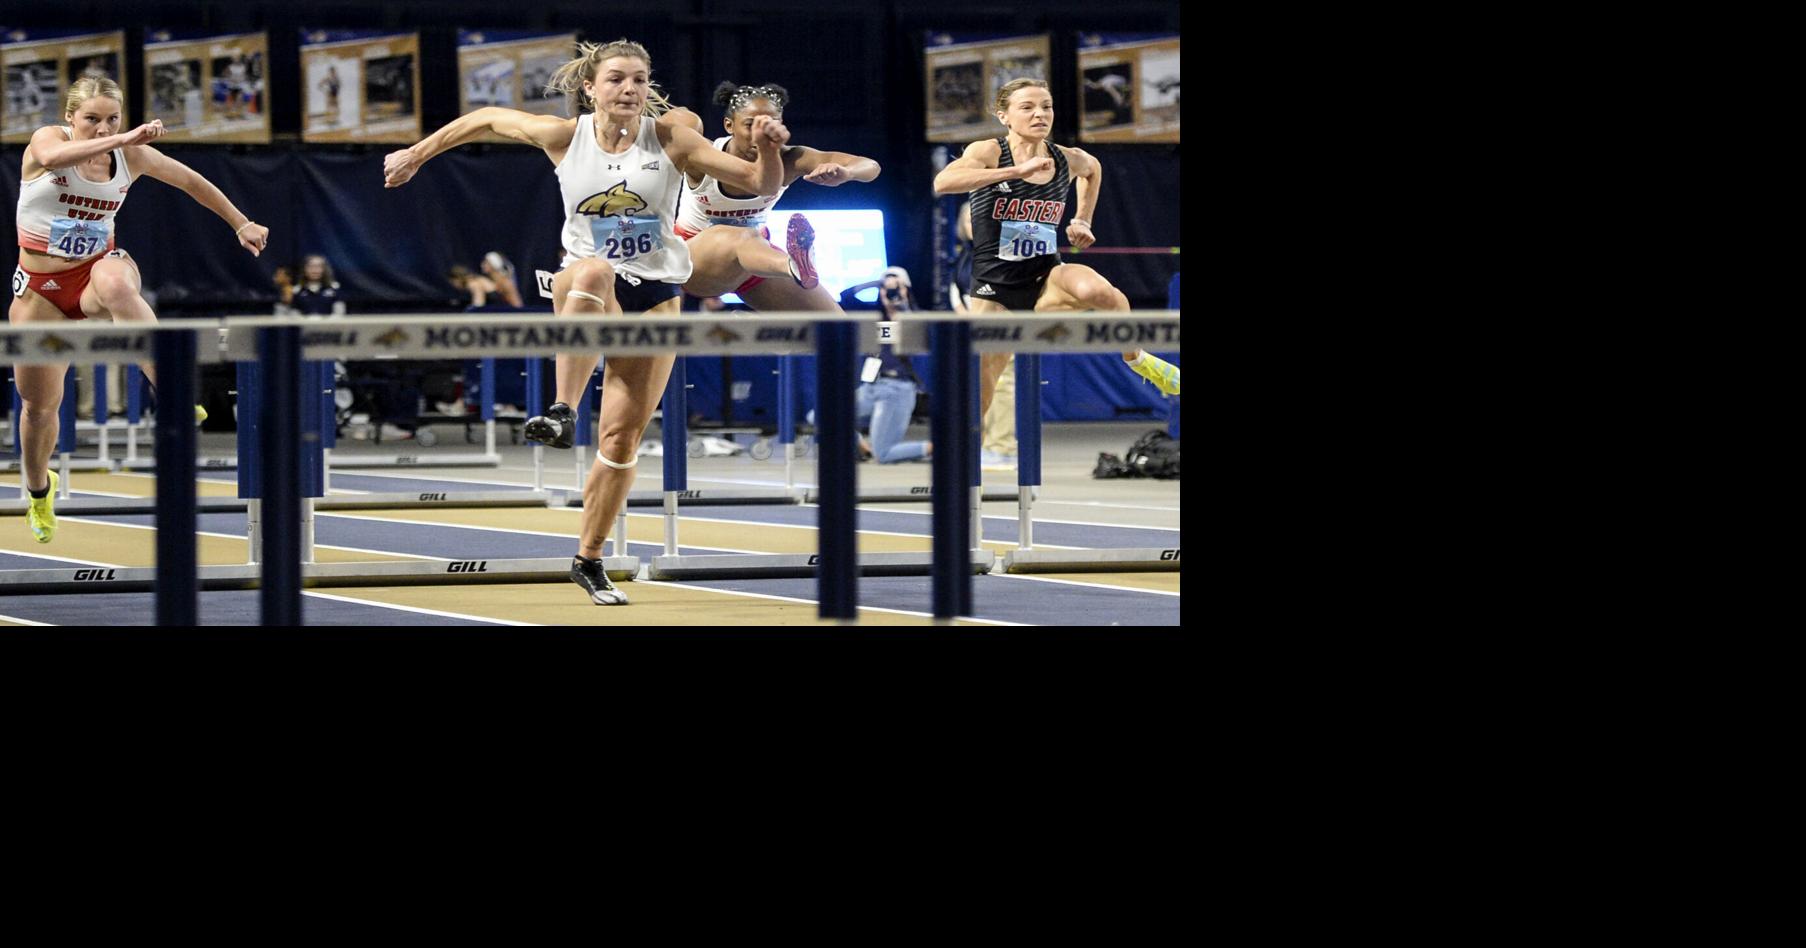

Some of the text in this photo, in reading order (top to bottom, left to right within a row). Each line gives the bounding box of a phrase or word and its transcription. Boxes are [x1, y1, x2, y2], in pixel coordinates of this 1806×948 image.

[58, 236, 99, 256] 467
[605, 233, 652, 259] 296
[1012, 238, 1047, 257] 109
[424, 325, 588, 348] MONTANA
[598, 325, 692, 346] STATE
[1085, 322, 1180, 344] MONT
[419, 493, 447, 501] GILL
[1160, 550, 1180, 561] GI
[73, 569, 116, 581] GILL
[447, 561, 487, 573] GILL
